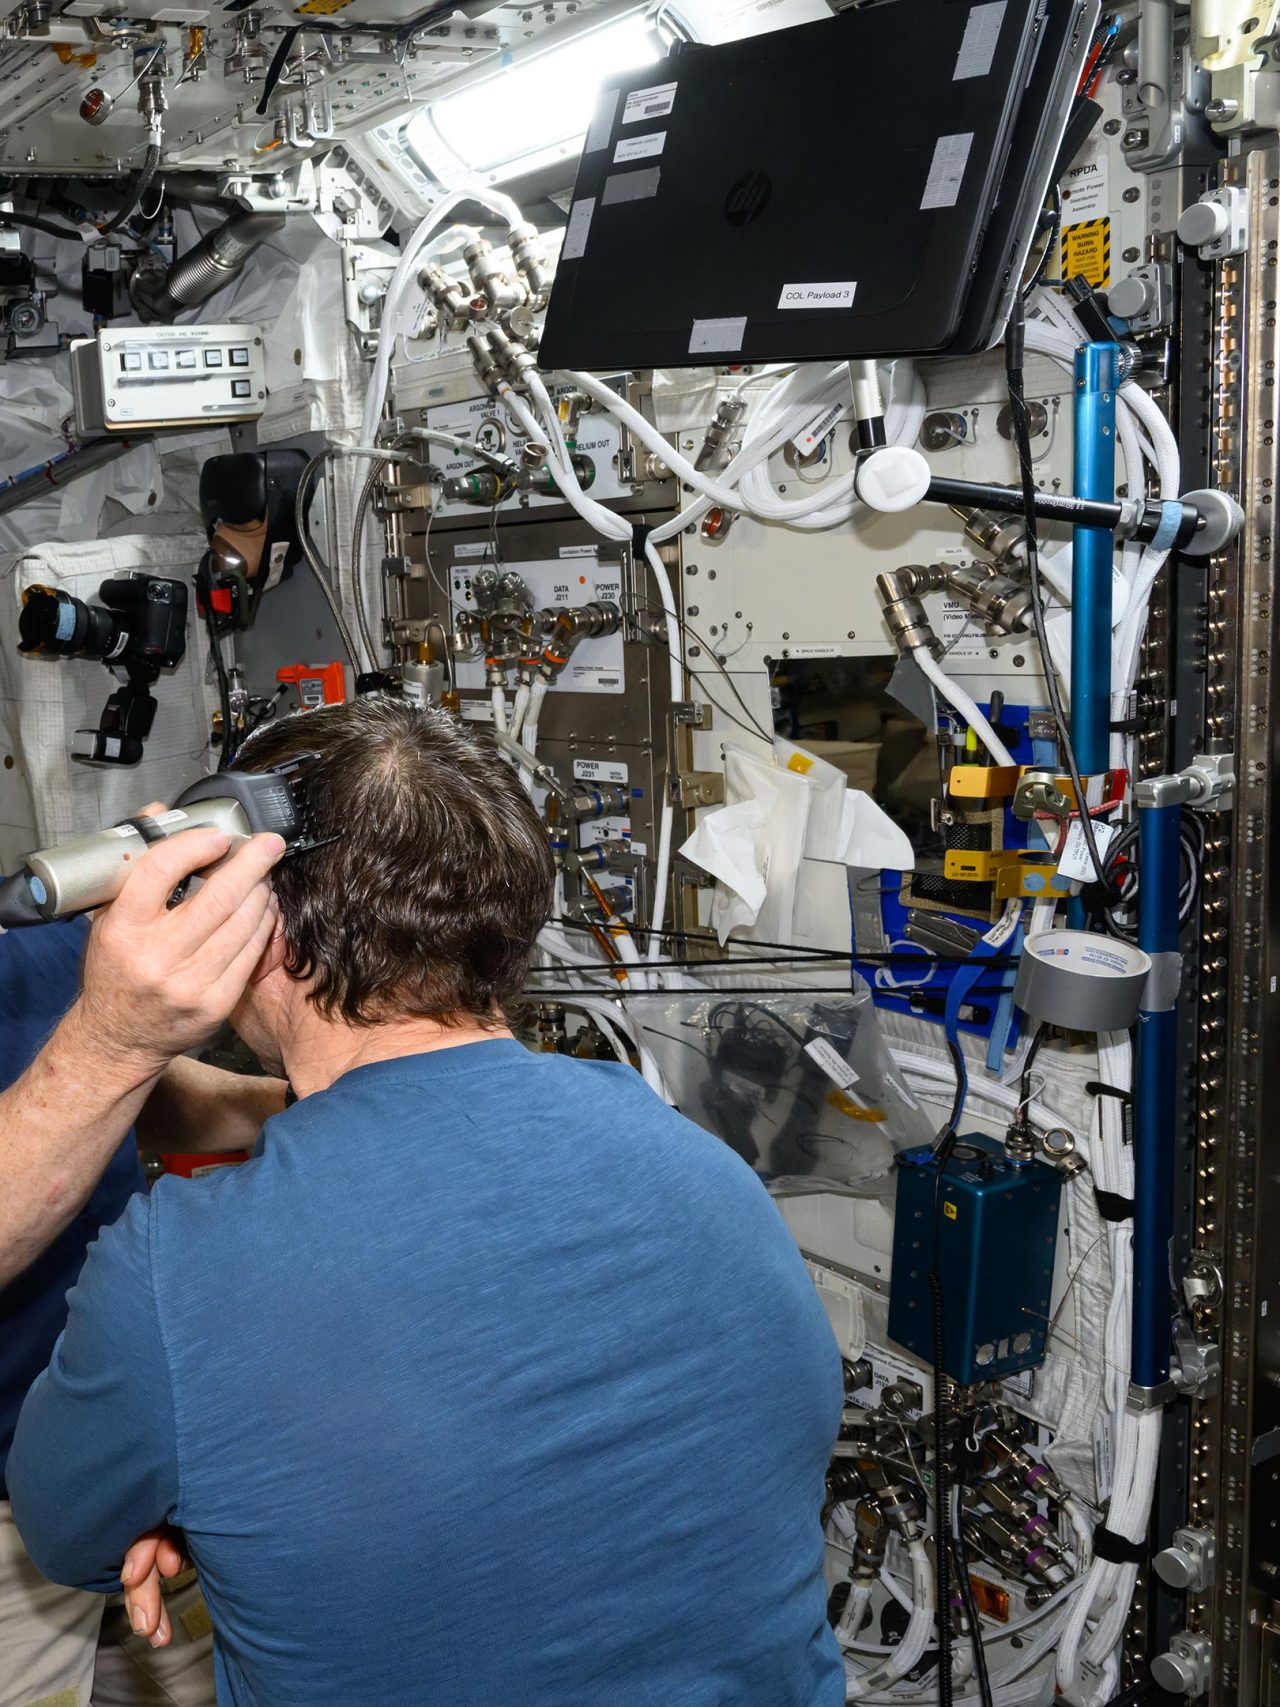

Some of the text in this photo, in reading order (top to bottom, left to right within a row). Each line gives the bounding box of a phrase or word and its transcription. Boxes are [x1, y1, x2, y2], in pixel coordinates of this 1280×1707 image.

[1070, 164, 1098, 178] RPDA
[1072, 203, 1096, 213] Assembly
[1072, 231, 1100, 241] WARNING
[1077, 241, 1094, 249] BURN
[1073, 247, 1098, 257] HAZARD
[807, 291, 841, 299] Payload
[556, 386, 577, 394] ARGON
[598, 440, 610, 448] OUT
[446, 462, 463, 470] ARGON
[596, 583, 619, 591] POWER
[943, 613, 963, 621] (Video
[576, 761, 599, 769] POWER
[581, 770, 595, 778] J231
[874, 1372, 890, 1384] DATA
